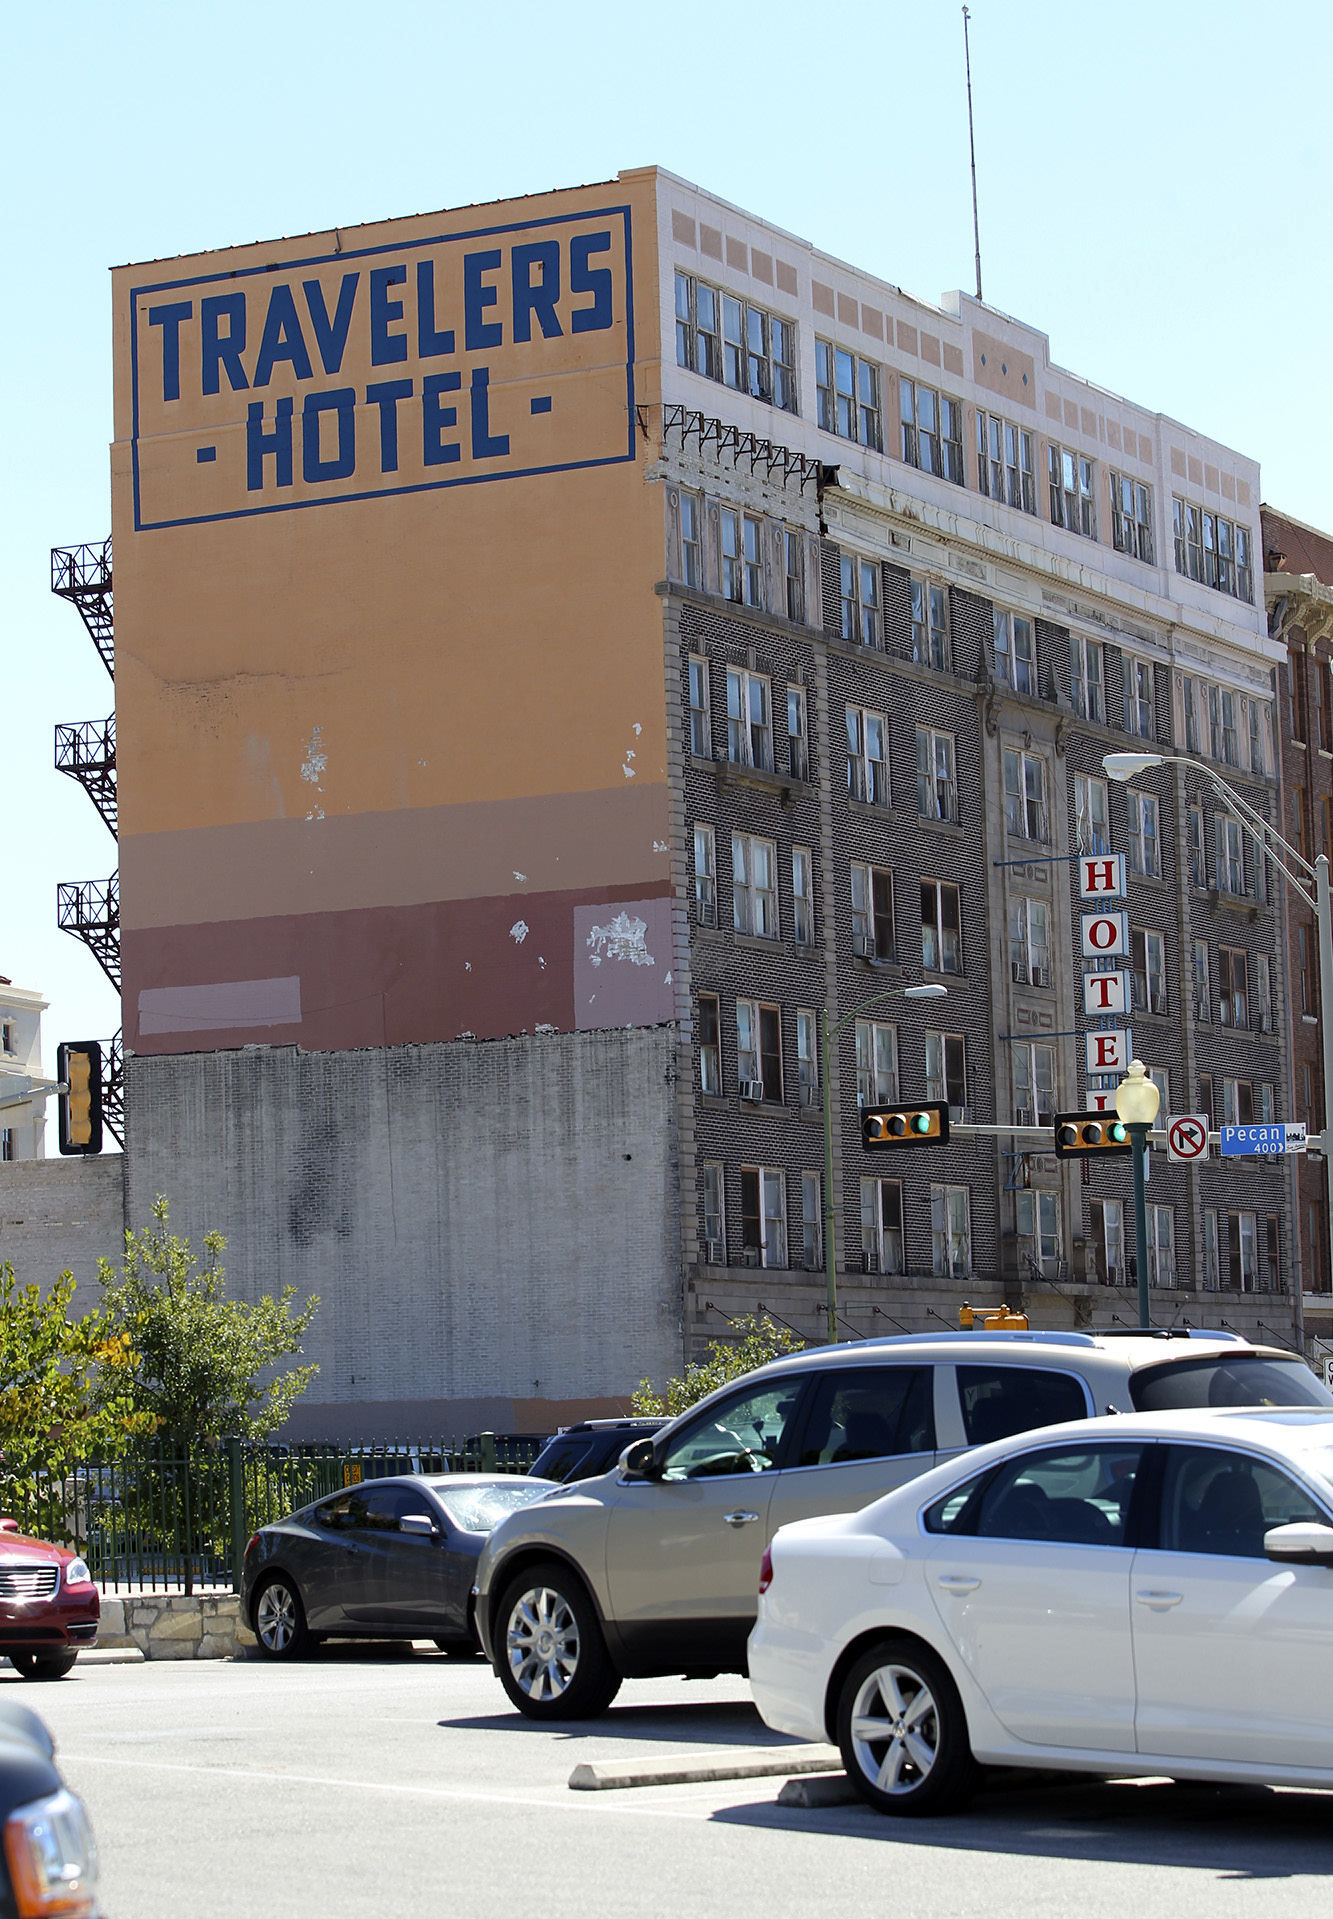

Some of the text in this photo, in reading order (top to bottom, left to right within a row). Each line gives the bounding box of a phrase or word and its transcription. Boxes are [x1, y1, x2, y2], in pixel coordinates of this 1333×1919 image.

[148, 231, 612, 402] TRAVELERS
[247, 367, 510, 491] HOTEL
[1226, 1127, 1280, 1142] Pecan
[1254, 1143, 1277, 1153] 400
